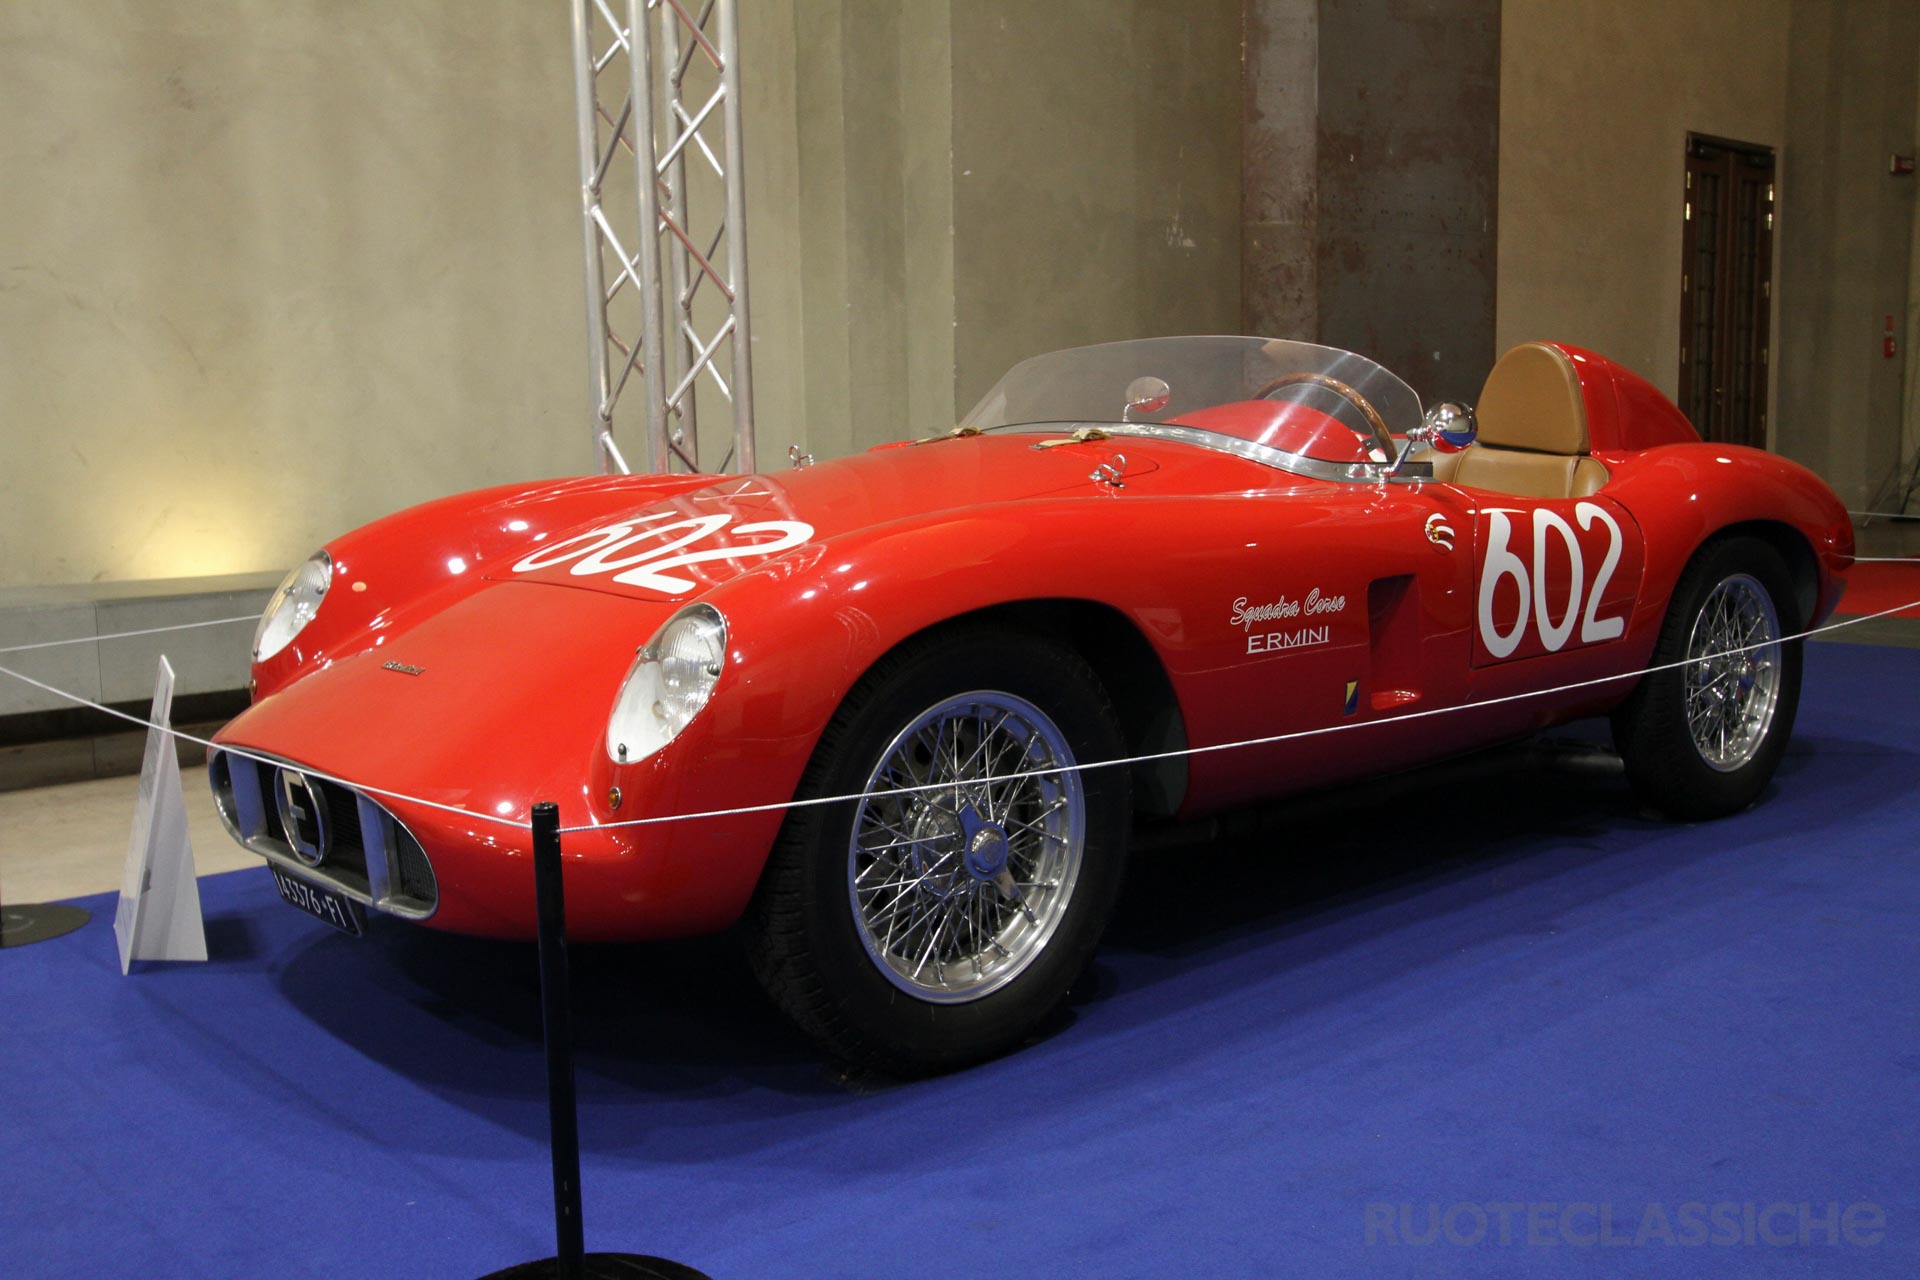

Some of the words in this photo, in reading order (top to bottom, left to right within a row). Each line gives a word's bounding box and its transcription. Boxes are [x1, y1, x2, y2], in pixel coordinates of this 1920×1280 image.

[511, 511, 815, 595] 602
[1478, 502, 1625, 659] 602
[1230, 596, 1300, 632] Squadra
[1304, 587, 1346, 616] Corse
[1247, 625, 1329, 654] ERMINI
